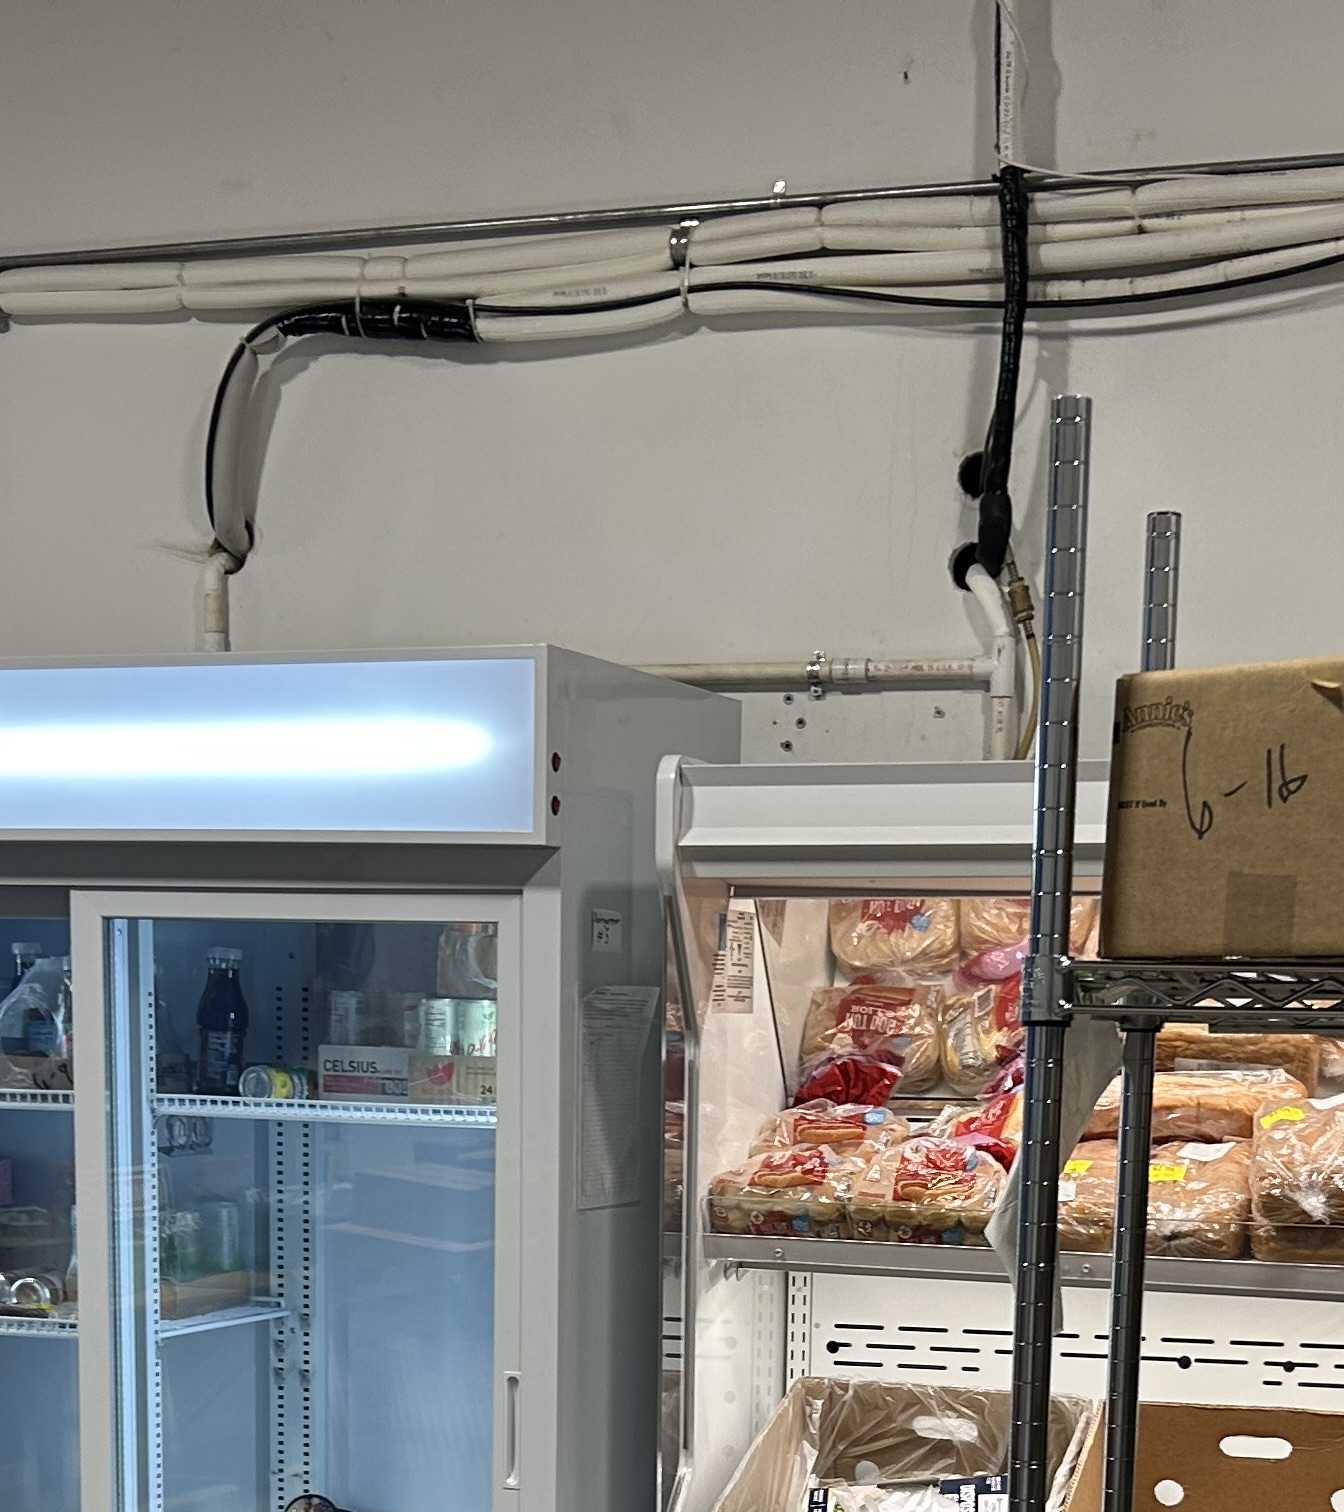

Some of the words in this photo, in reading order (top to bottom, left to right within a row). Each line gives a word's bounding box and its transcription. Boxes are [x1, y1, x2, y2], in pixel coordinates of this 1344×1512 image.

[1123, 696, 1195, 733] Annie's
[323, 1058, 378, 1074] CELSIUS
[480, 1084, 493, 1095] 24
